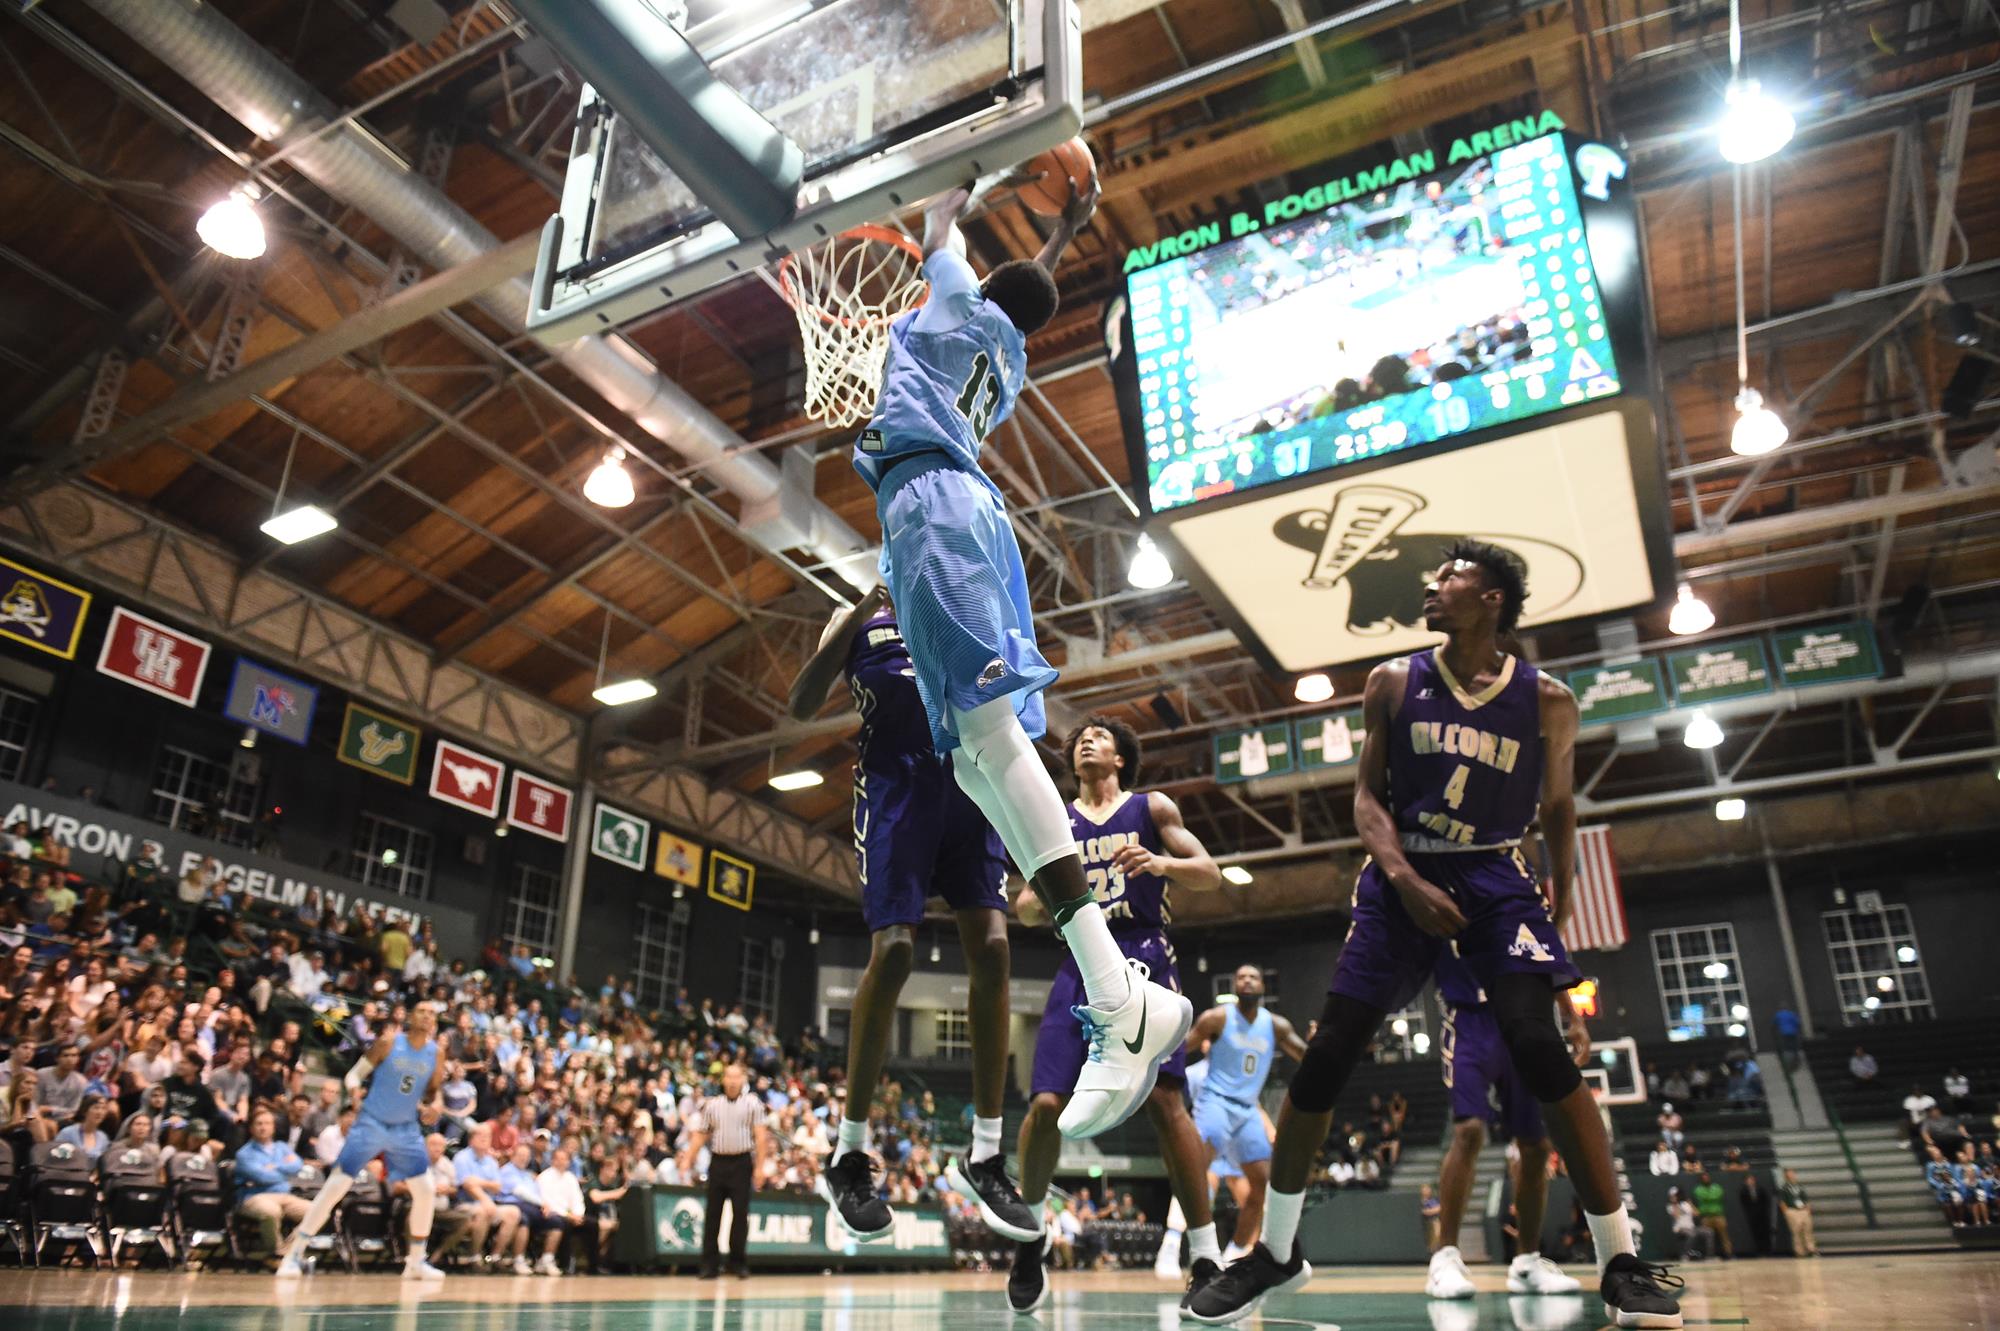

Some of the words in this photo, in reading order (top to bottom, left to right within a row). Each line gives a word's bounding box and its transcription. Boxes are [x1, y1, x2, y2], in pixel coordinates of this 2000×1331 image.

[1122, 221, 1220, 273] AVRON
[1230, 212, 1260, 237] B.
[1264, 149, 1436, 225] FOGELMAN
[1447, 109, 1566, 164] ARENA
[954, 350, 1001, 445] 13
[865, 431, 876, 439] XL
[1410, 721, 1521, 774] ALCORN
[530, 786, 555, 826] T
[1443, 763, 1471, 810] 4
[2, 803, 133, 862] AVRON
[1075, 831, 1140, 865] LCORN
[1087, 864, 1126, 903] 23
[1243, 1053, 1258, 1077] 0
[400, 1075, 416, 1095] 5
[747, 1213, 813, 1243] LANE
